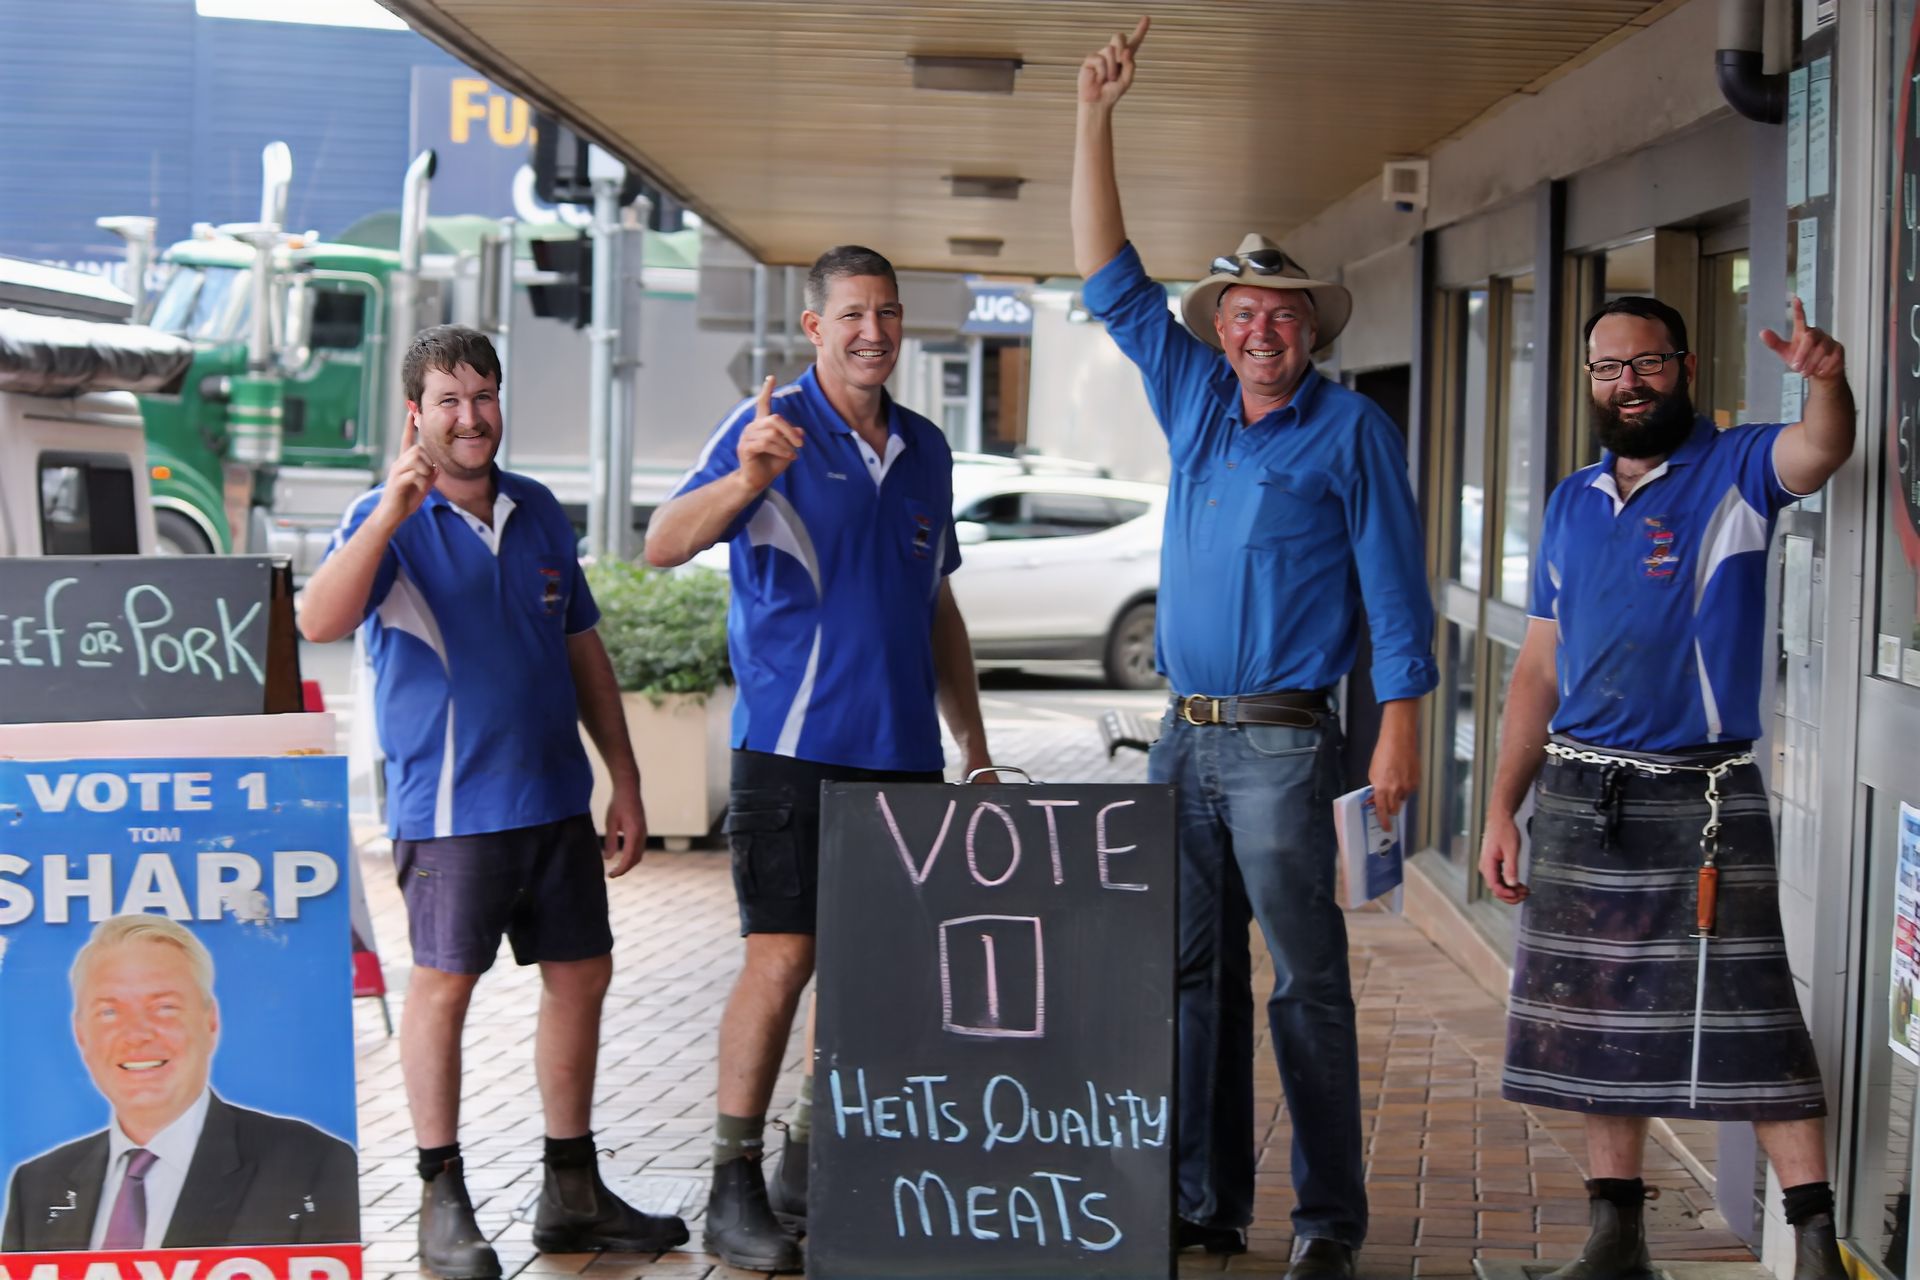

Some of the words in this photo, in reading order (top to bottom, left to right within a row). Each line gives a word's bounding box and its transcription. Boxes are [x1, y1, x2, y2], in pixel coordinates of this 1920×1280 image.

[968, 296, 1032, 322] UGS
[80, 628, 123, 656] OR
[125, 585, 265, 685] PORK
[26, 772, 213, 812] VOTE
[238, 772, 267, 810] 1
[128, 827, 181, 843] TOM
[876, 791, 1149, 891] VOTE
[0, 850, 339, 925] SHARP
[981, 934, 999, 1024] 1
[893, 1170, 1123, 1251] MEATS
